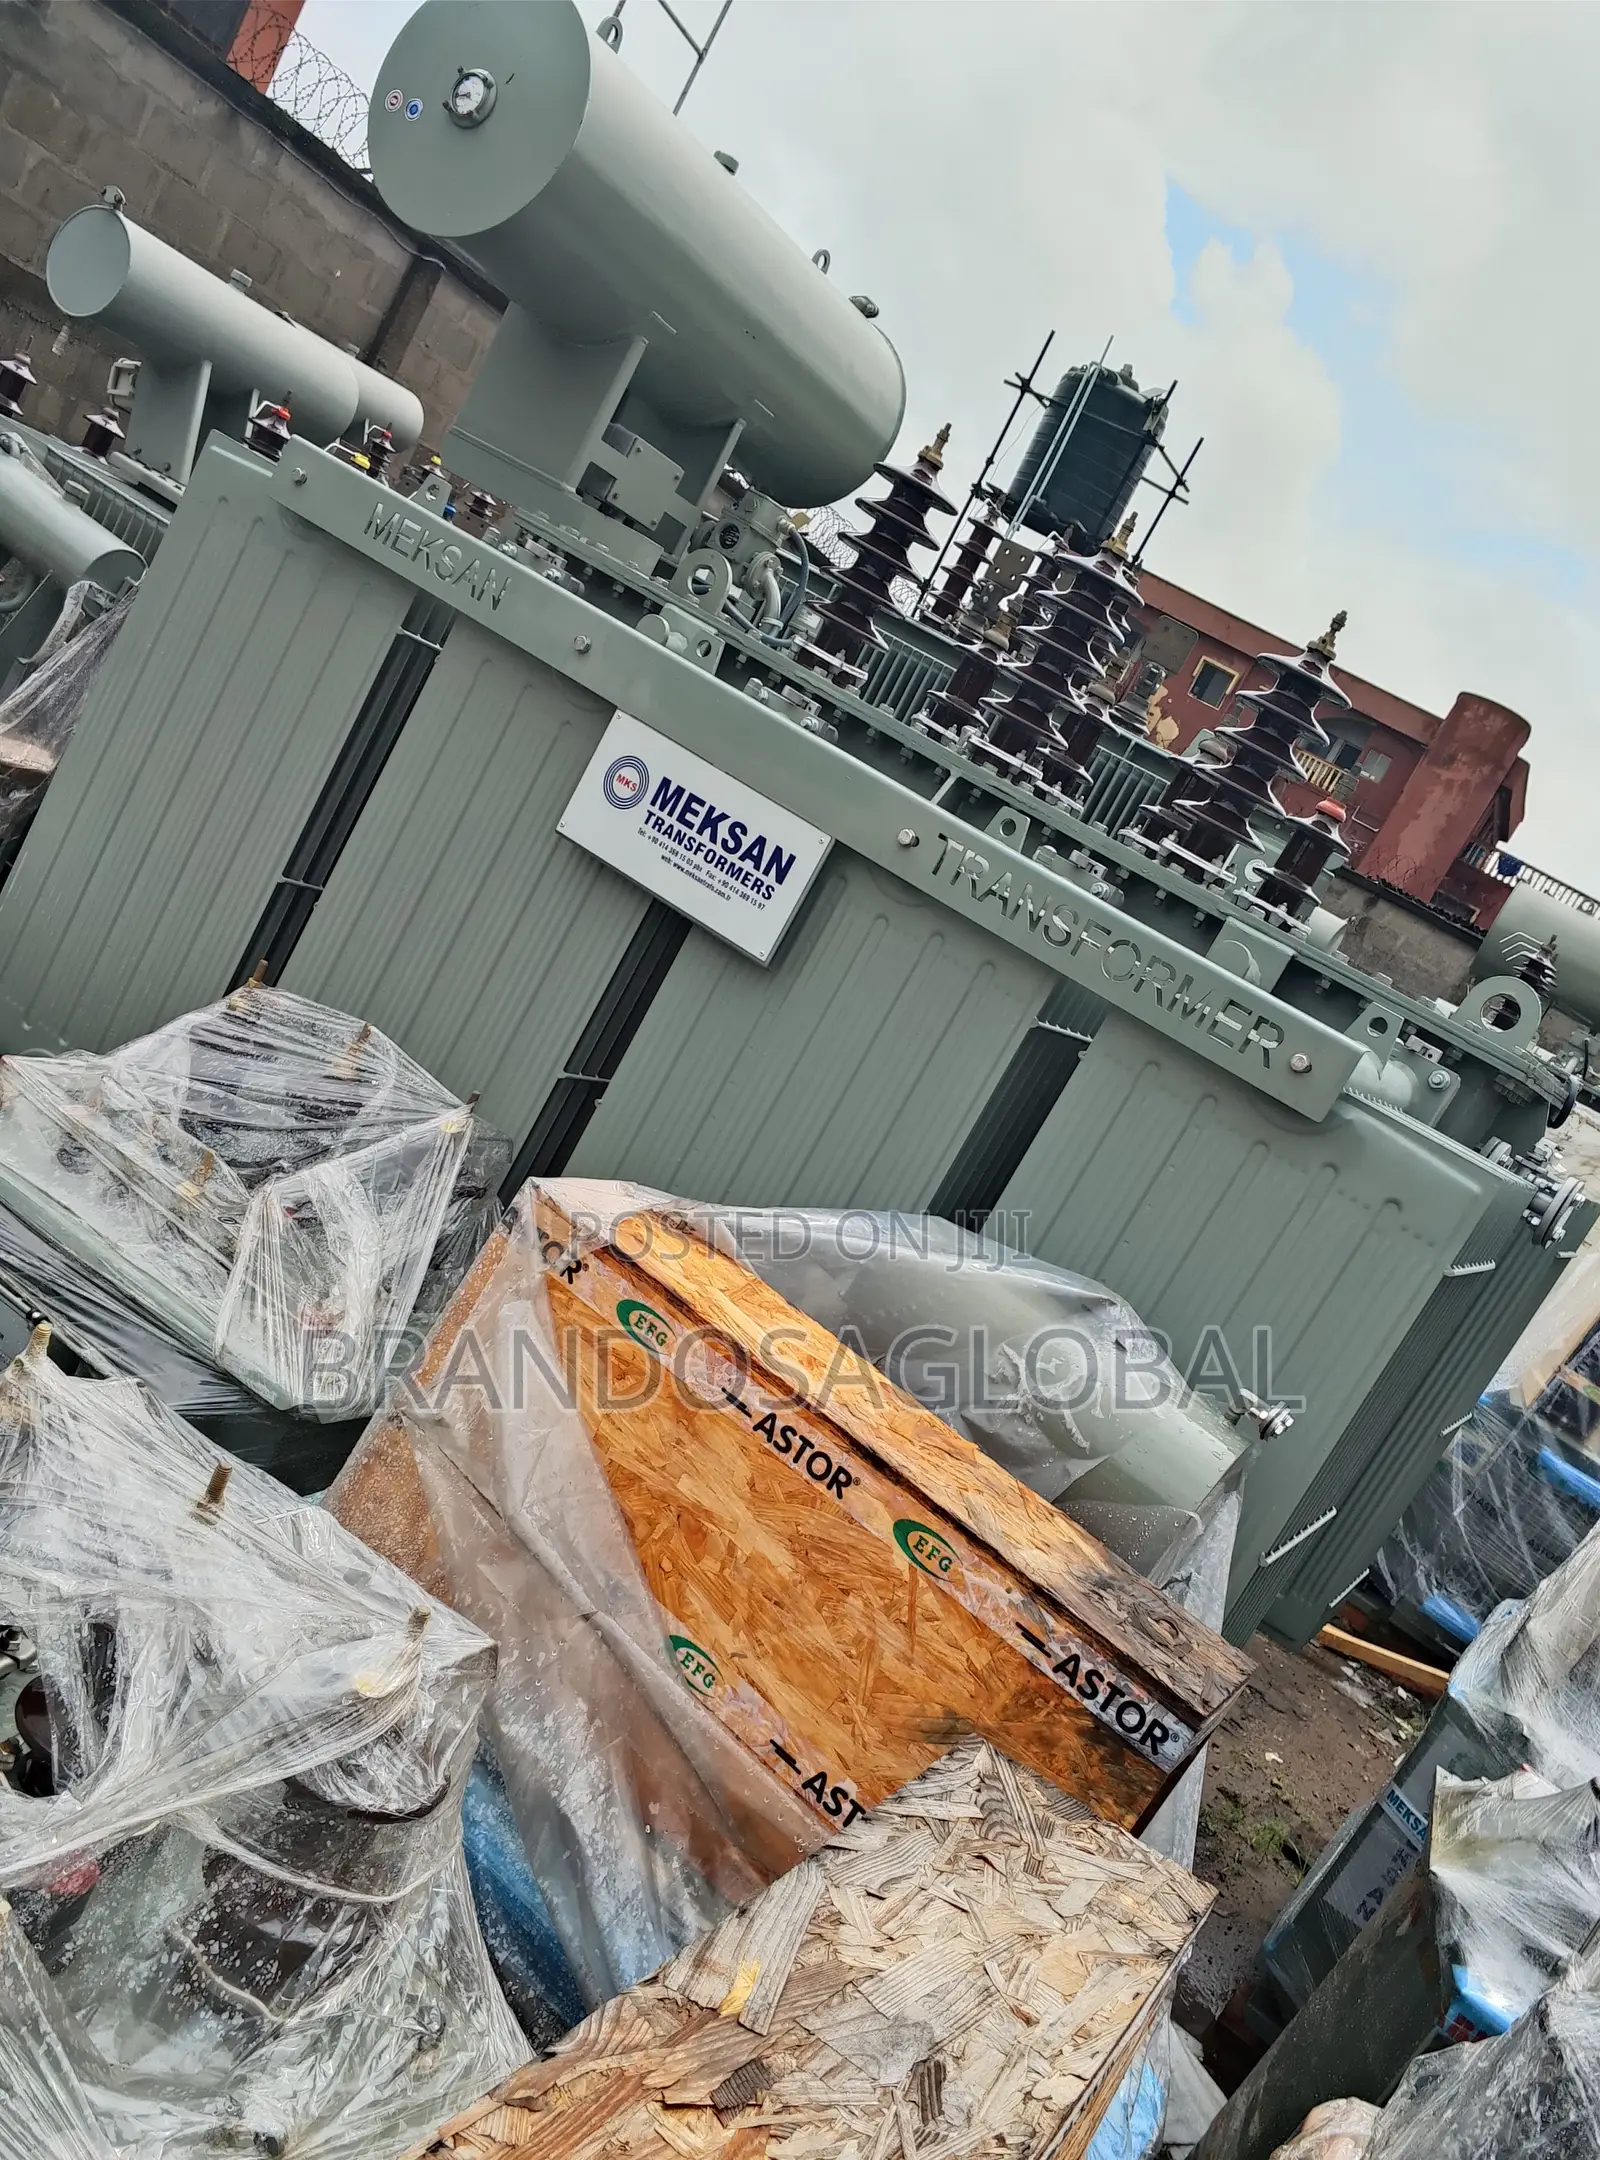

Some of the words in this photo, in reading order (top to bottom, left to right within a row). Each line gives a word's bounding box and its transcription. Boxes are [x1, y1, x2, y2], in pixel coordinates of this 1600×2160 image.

[364, 501, 512, 611] MEKSAN
[616, 773, 638, 792] MKS
[644, 809, 775, 900] TRANSFORMERS
[650, 776, 796, 885] MEKSAN
[932, 833, 1284, 1069] TRANSFORMER
[634, 1313, 668, 1347] EFG
[913, 1535, 953, 1573] EFG
[680, 1651, 716, 1689] EFG
